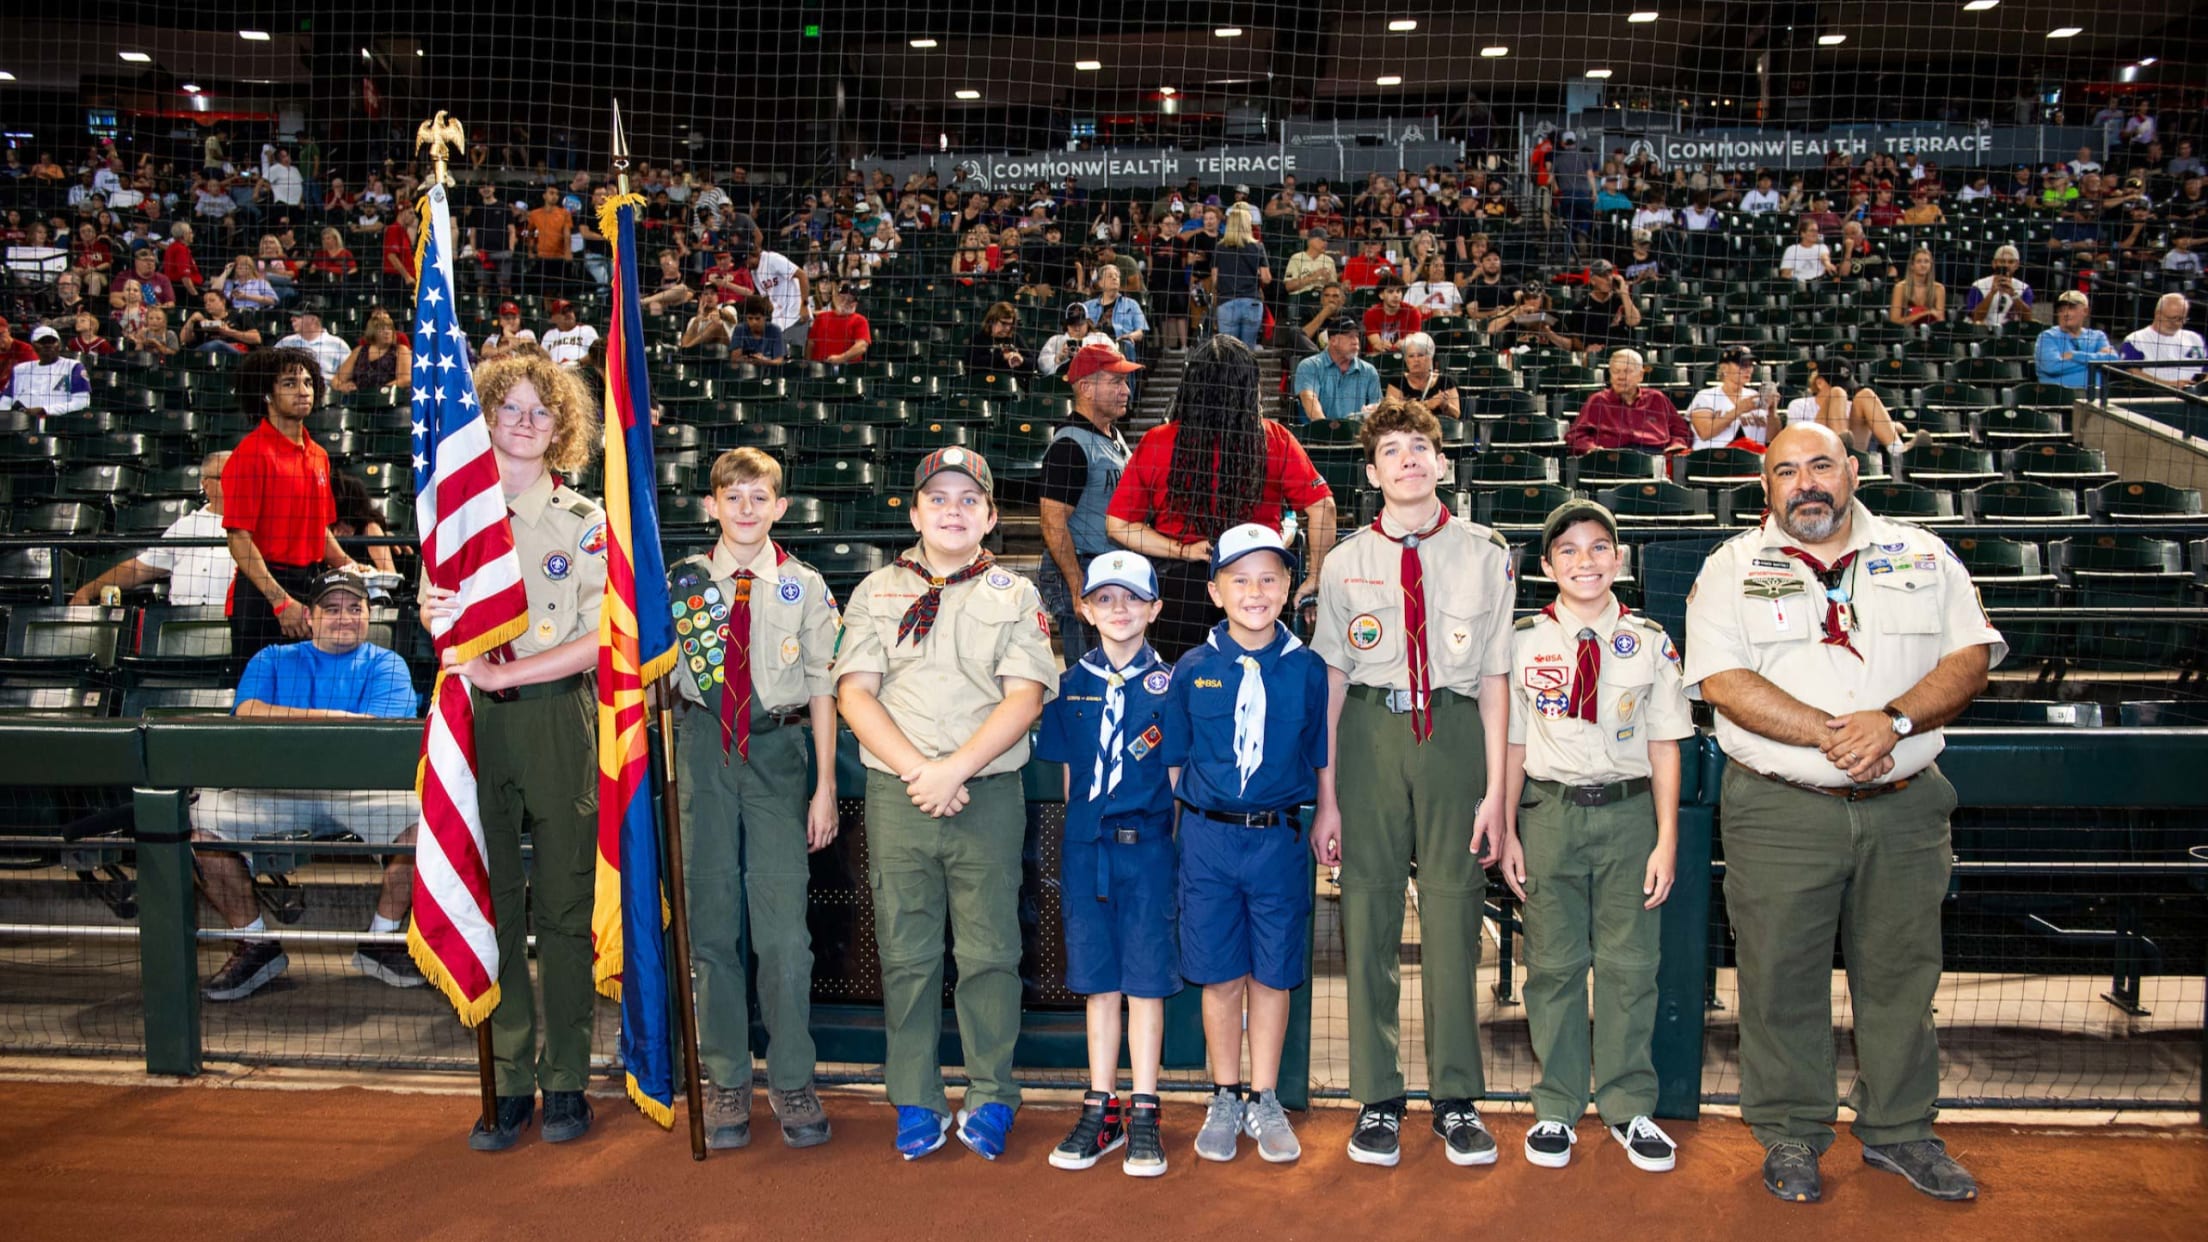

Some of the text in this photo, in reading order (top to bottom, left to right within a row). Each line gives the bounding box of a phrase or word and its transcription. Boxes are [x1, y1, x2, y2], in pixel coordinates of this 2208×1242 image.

[1668, 135, 1992, 159] COMMONWEALTH TERRACE
[993, 155, 1296, 179] COMMONWEALTH TERRACE
[1205, 679, 1223, 688] BSA
